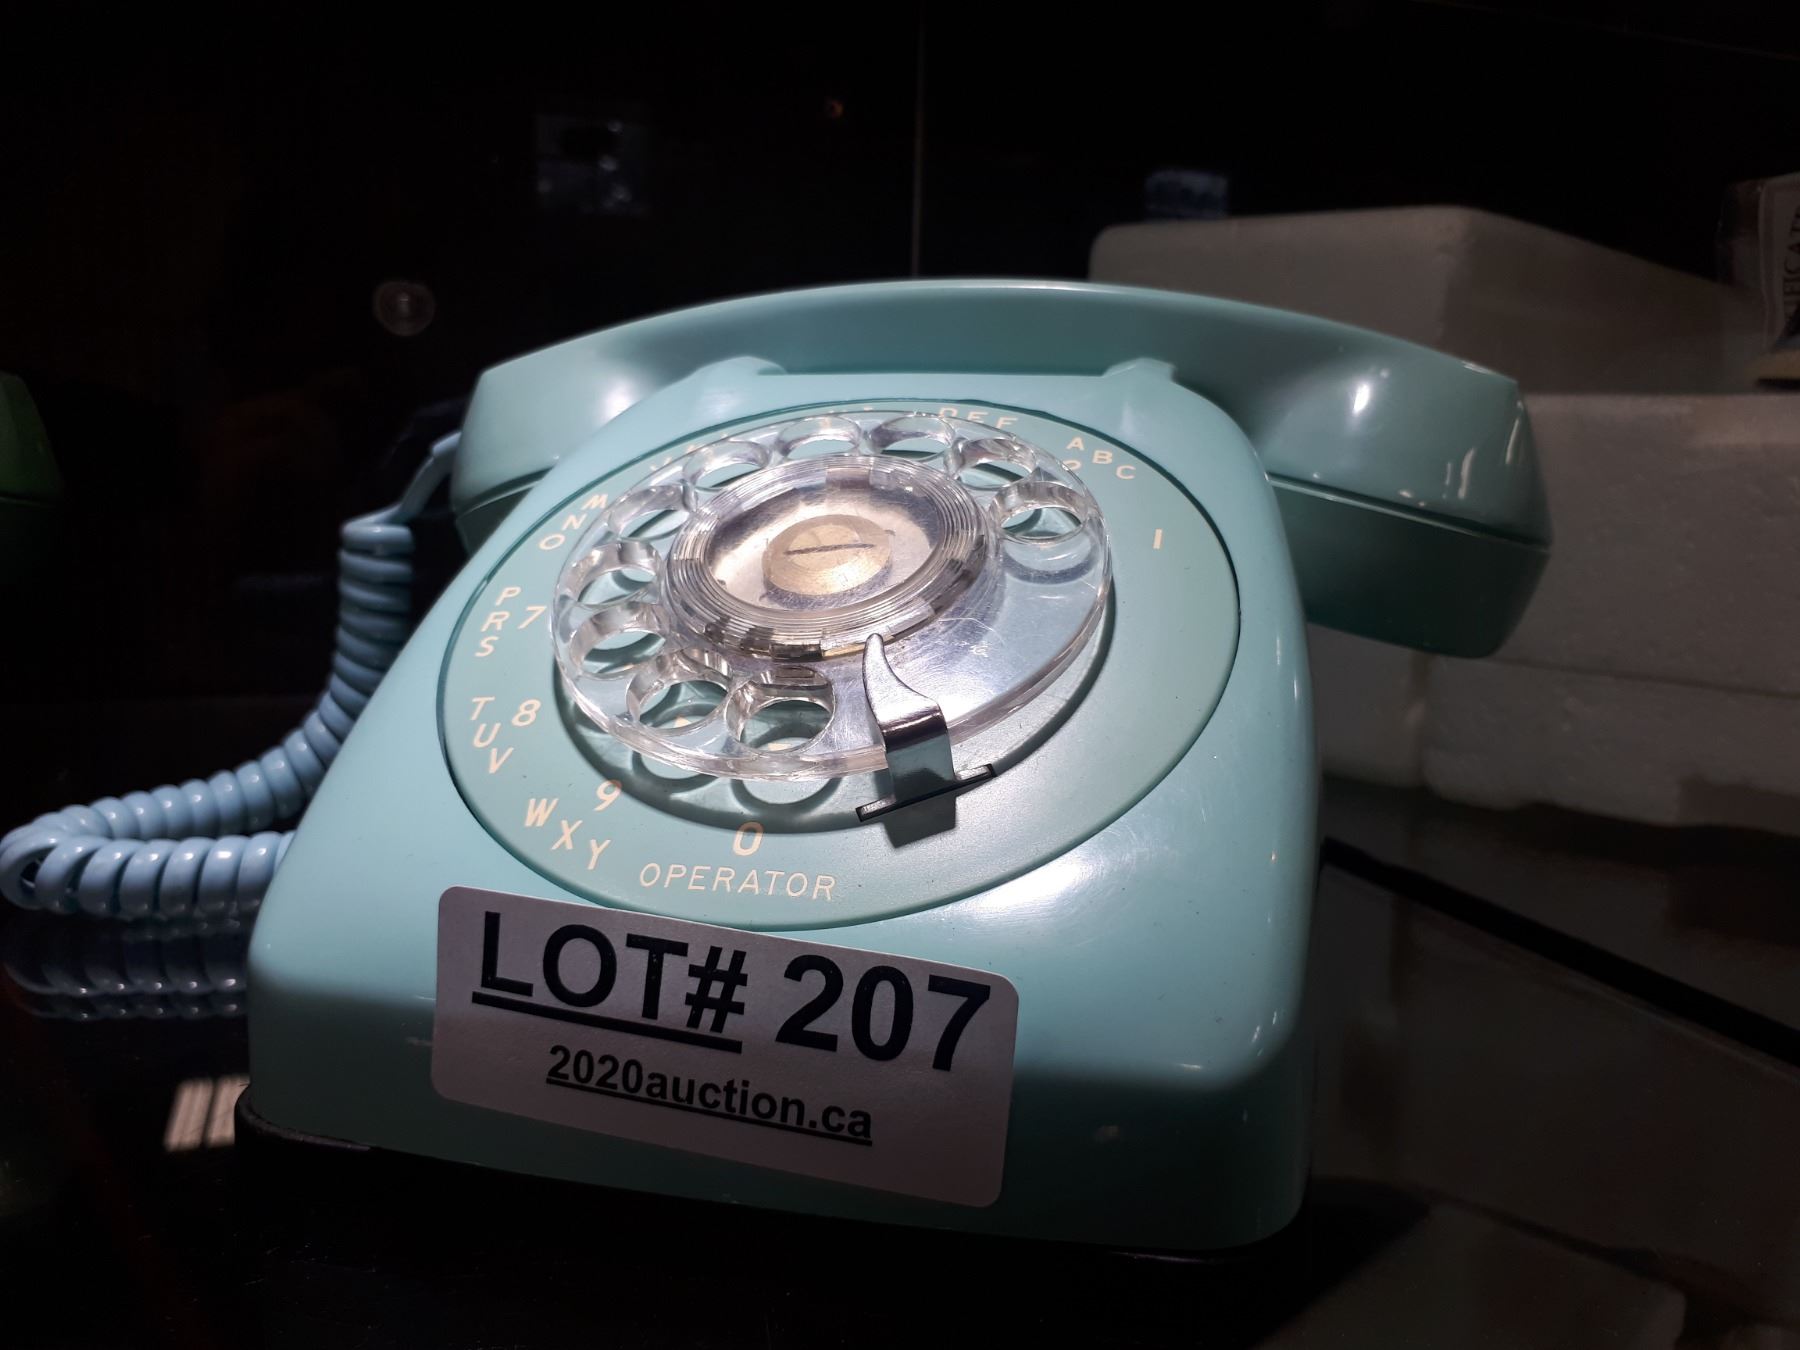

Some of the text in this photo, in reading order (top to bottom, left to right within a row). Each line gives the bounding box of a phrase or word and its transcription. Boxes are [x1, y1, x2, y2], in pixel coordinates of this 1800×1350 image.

[1066, 437, 1136, 480] ABC
[474, 586, 522, 658] PRS
[517, 606, 547, 630] 7
[471, 697, 514, 774] TUV
[512, 699, 541, 727] 8
[594, 779, 622, 811] 9
[524, 797, 611, 870] WXY
[639, 862, 837, 900] OPERATOR
[480, 911, 992, 1072] LOT# 207
[547, 1044, 873, 1139] 2020auction.ca
